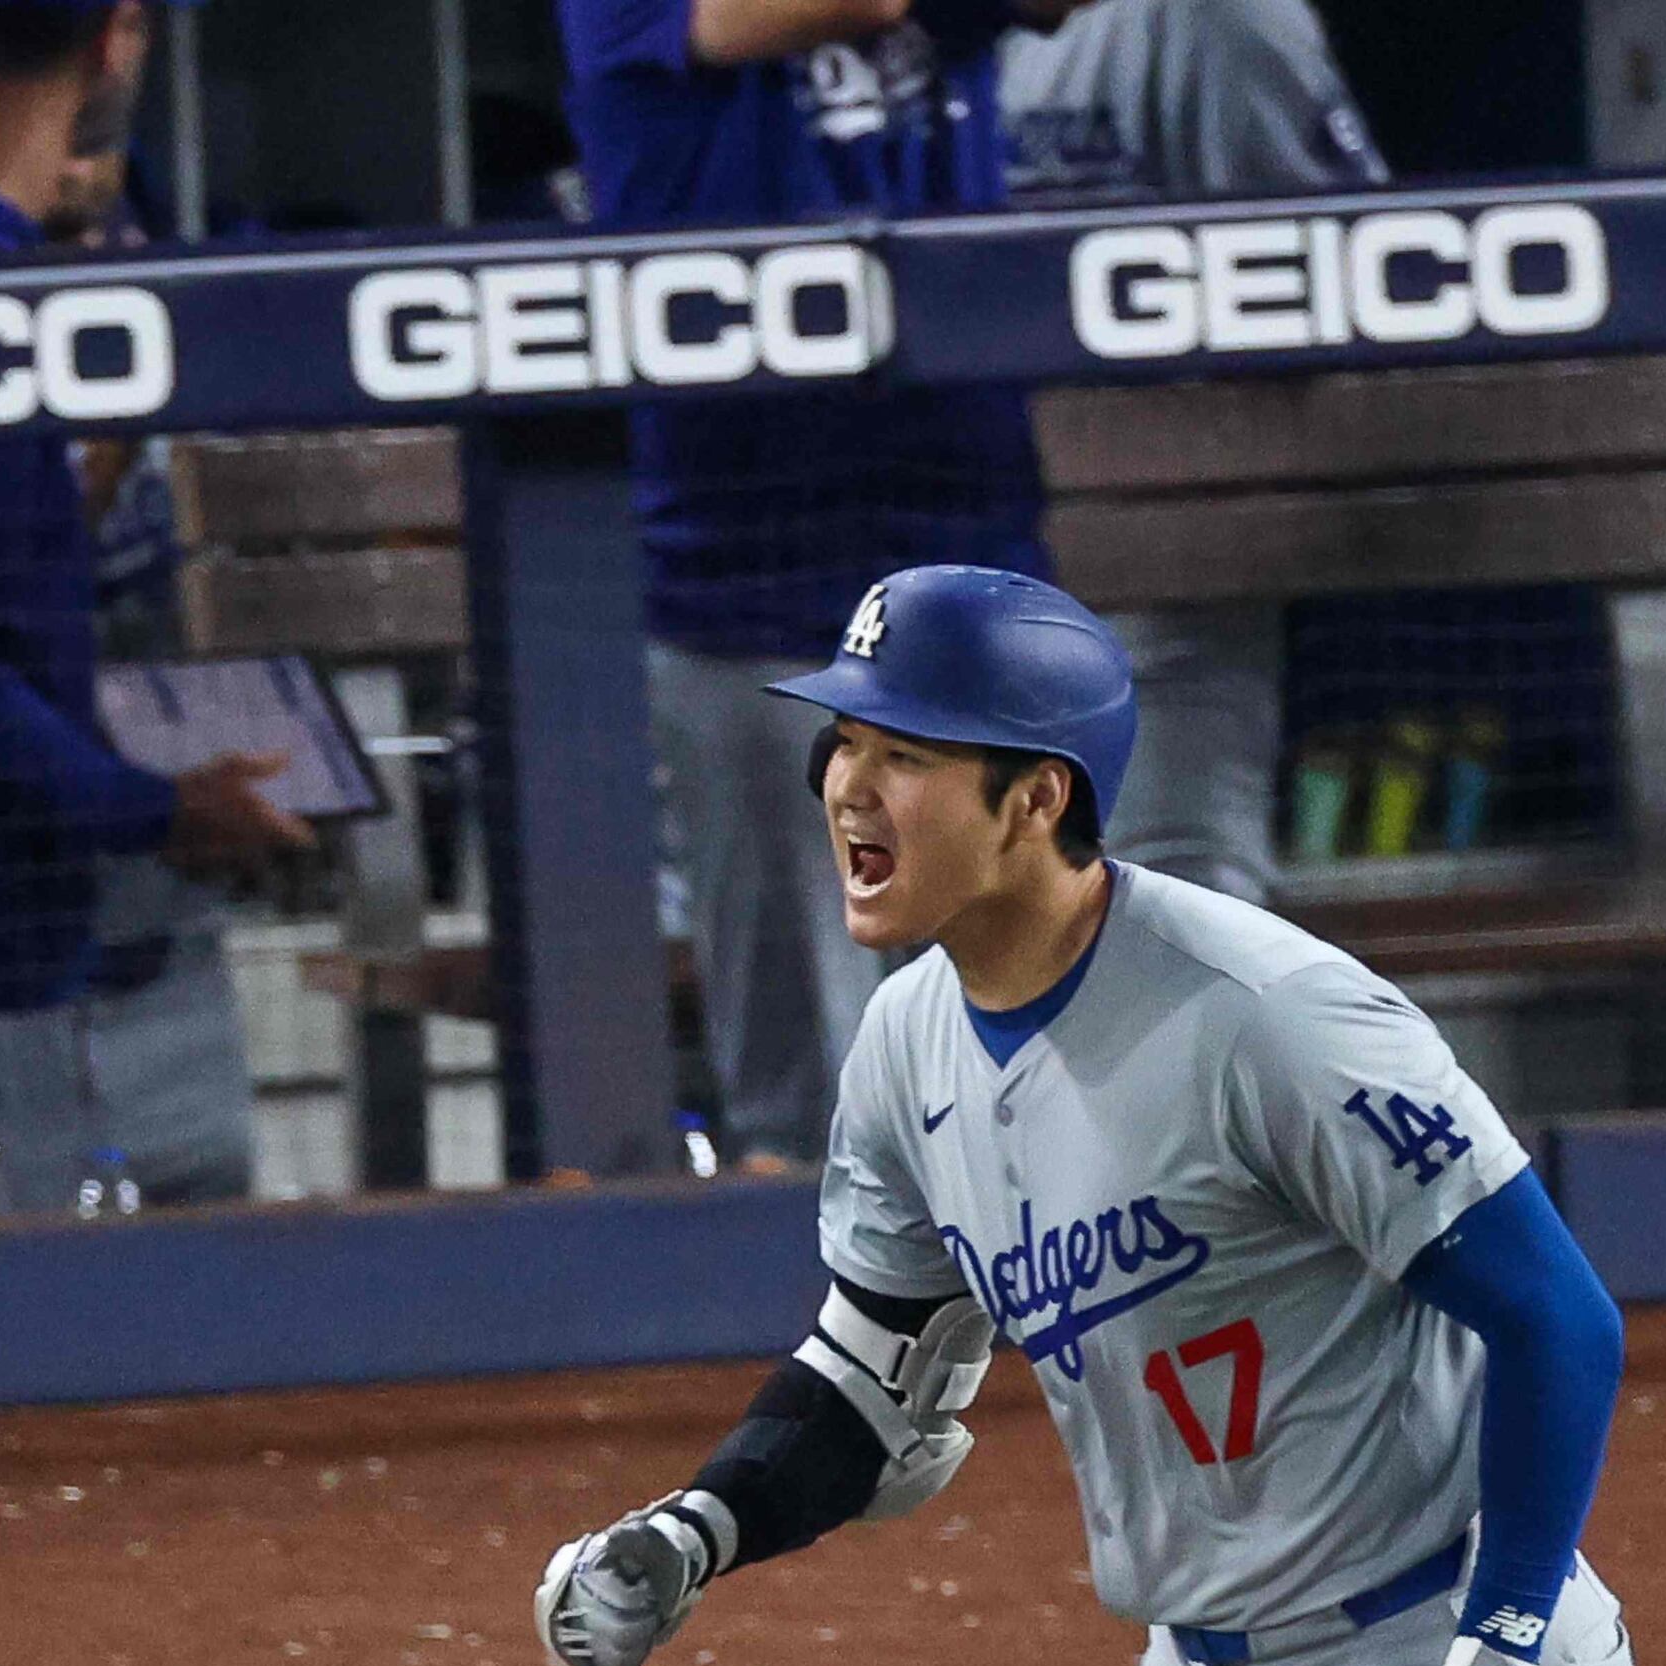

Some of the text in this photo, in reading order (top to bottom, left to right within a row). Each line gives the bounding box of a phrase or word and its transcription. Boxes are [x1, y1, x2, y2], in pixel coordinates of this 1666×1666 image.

[349, 243, 895, 401] GEICO
[1071, 203, 1608, 359] GEICO
[843, 584, 886, 658] LA
[1343, 1088, 1473, 1186] LA
[1145, 1319, 1263, 1464] 17
